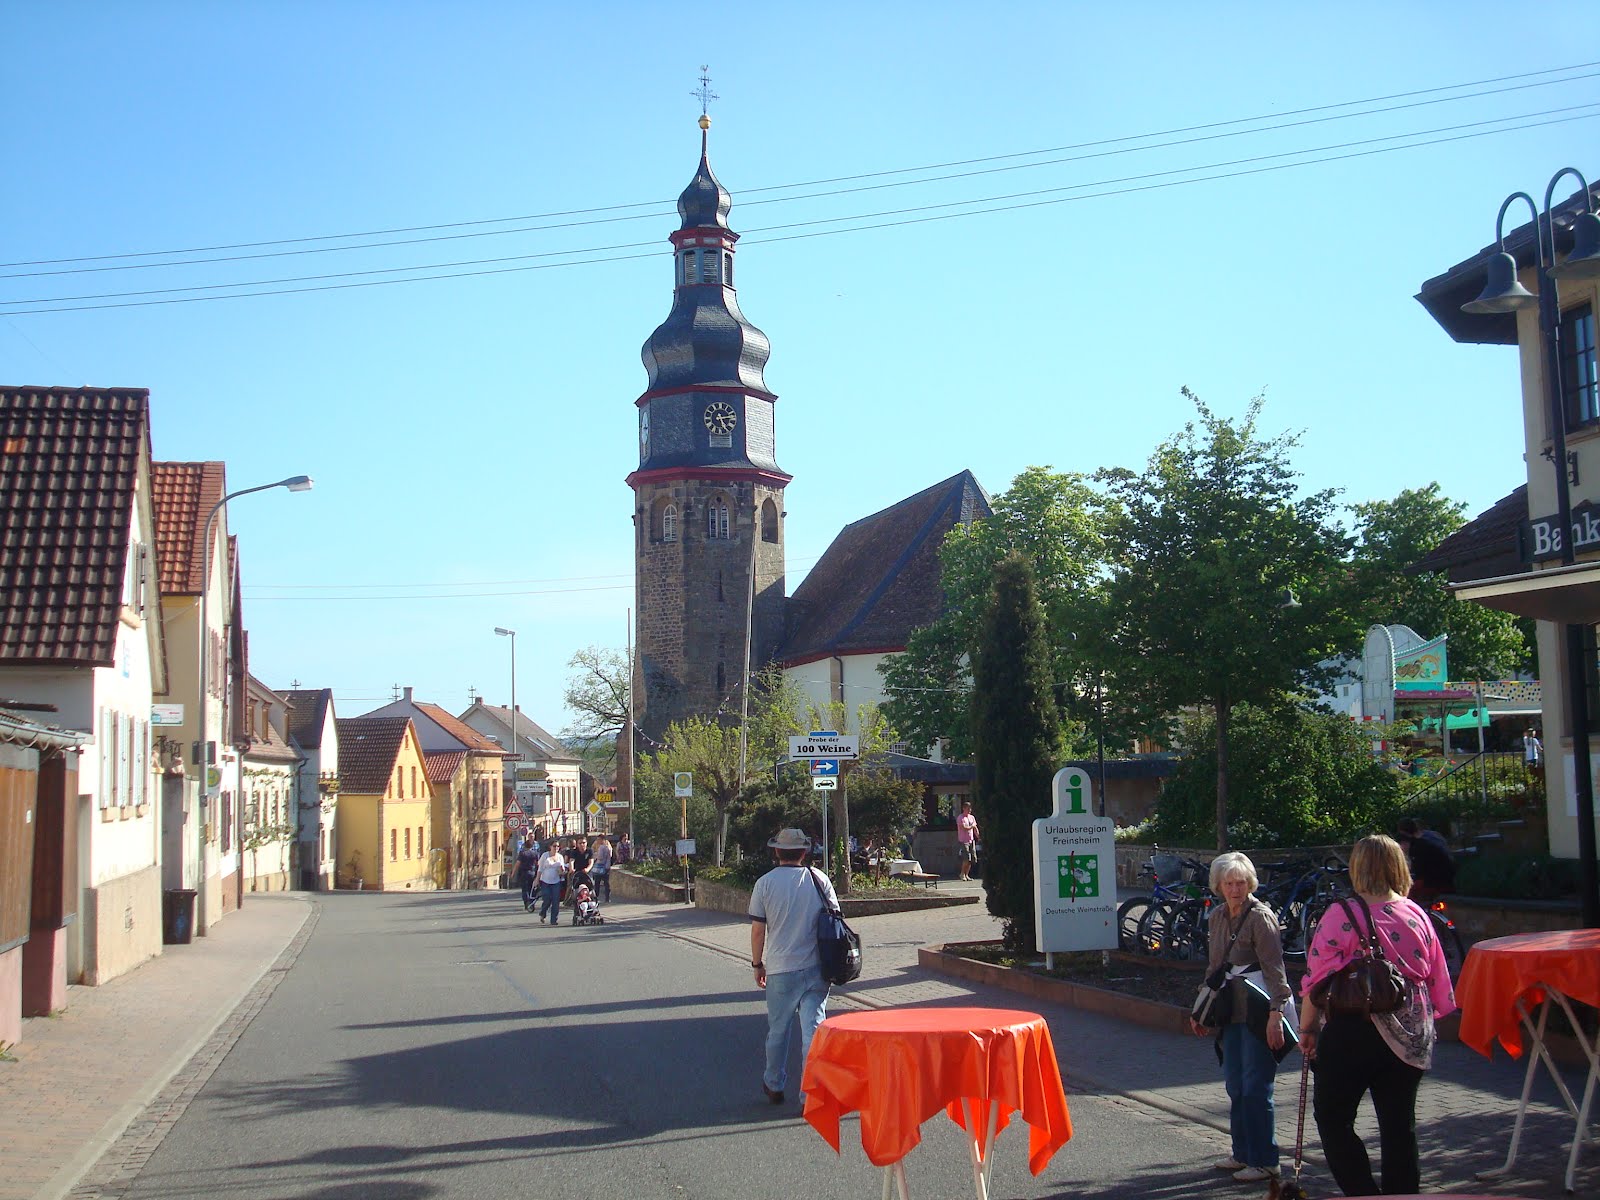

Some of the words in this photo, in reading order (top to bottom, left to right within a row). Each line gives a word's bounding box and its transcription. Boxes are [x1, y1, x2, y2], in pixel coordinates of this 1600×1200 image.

[797, 745, 815, 753] 100
[818, 745, 852, 753] Weine
[510, 819, 519, 827] 30
[1045, 825, 1107, 835] Urlaubsregion
[1052, 836, 1100, 845] Freinsheim
[1045, 907, 1075, 915] Deutsche
[1078, 905, 1114, 913] Weinstraße
